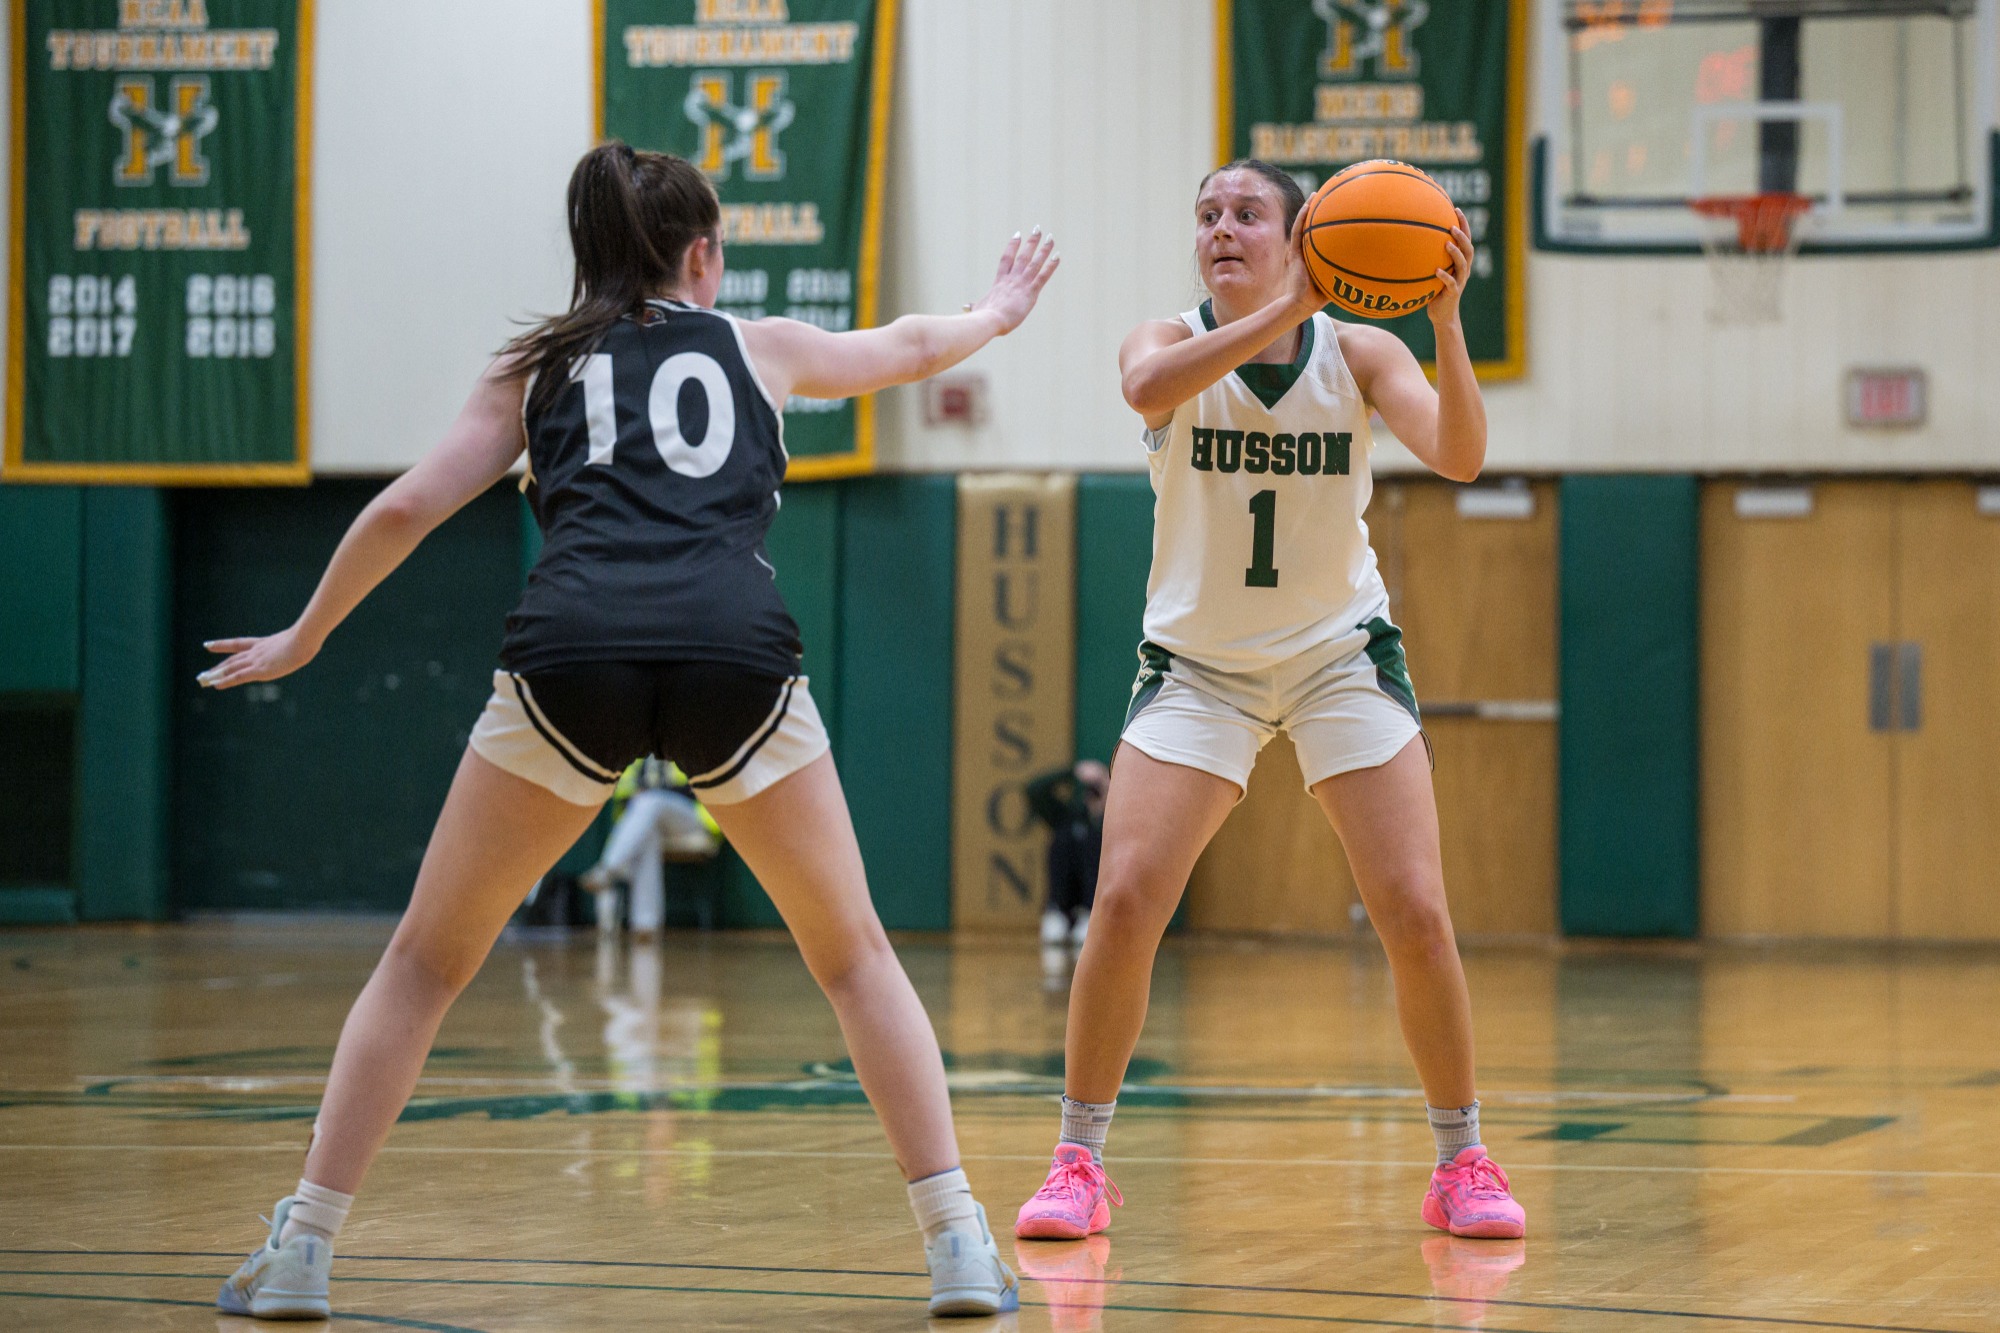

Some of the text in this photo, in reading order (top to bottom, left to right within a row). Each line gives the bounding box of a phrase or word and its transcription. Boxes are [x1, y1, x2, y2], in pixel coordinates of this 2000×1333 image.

[47, 28, 279, 71] TOURNAMENT
[623, 21, 859, 68] TOURNAMENT
[1250, 121, 1484, 164] BASKETBALL
[74, 208, 250, 250] FOOTBALL
[48, 273, 137, 316] 2014
[1332, 274, 1435, 312] Wilson
[48, 316, 137, 358] 2017
[566, 351, 736, 479] 10
[1190, 425, 1353, 476] HUSSON
[1244, 488, 1279, 588] 1
[986, 504, 1042, 910] HUSSON
